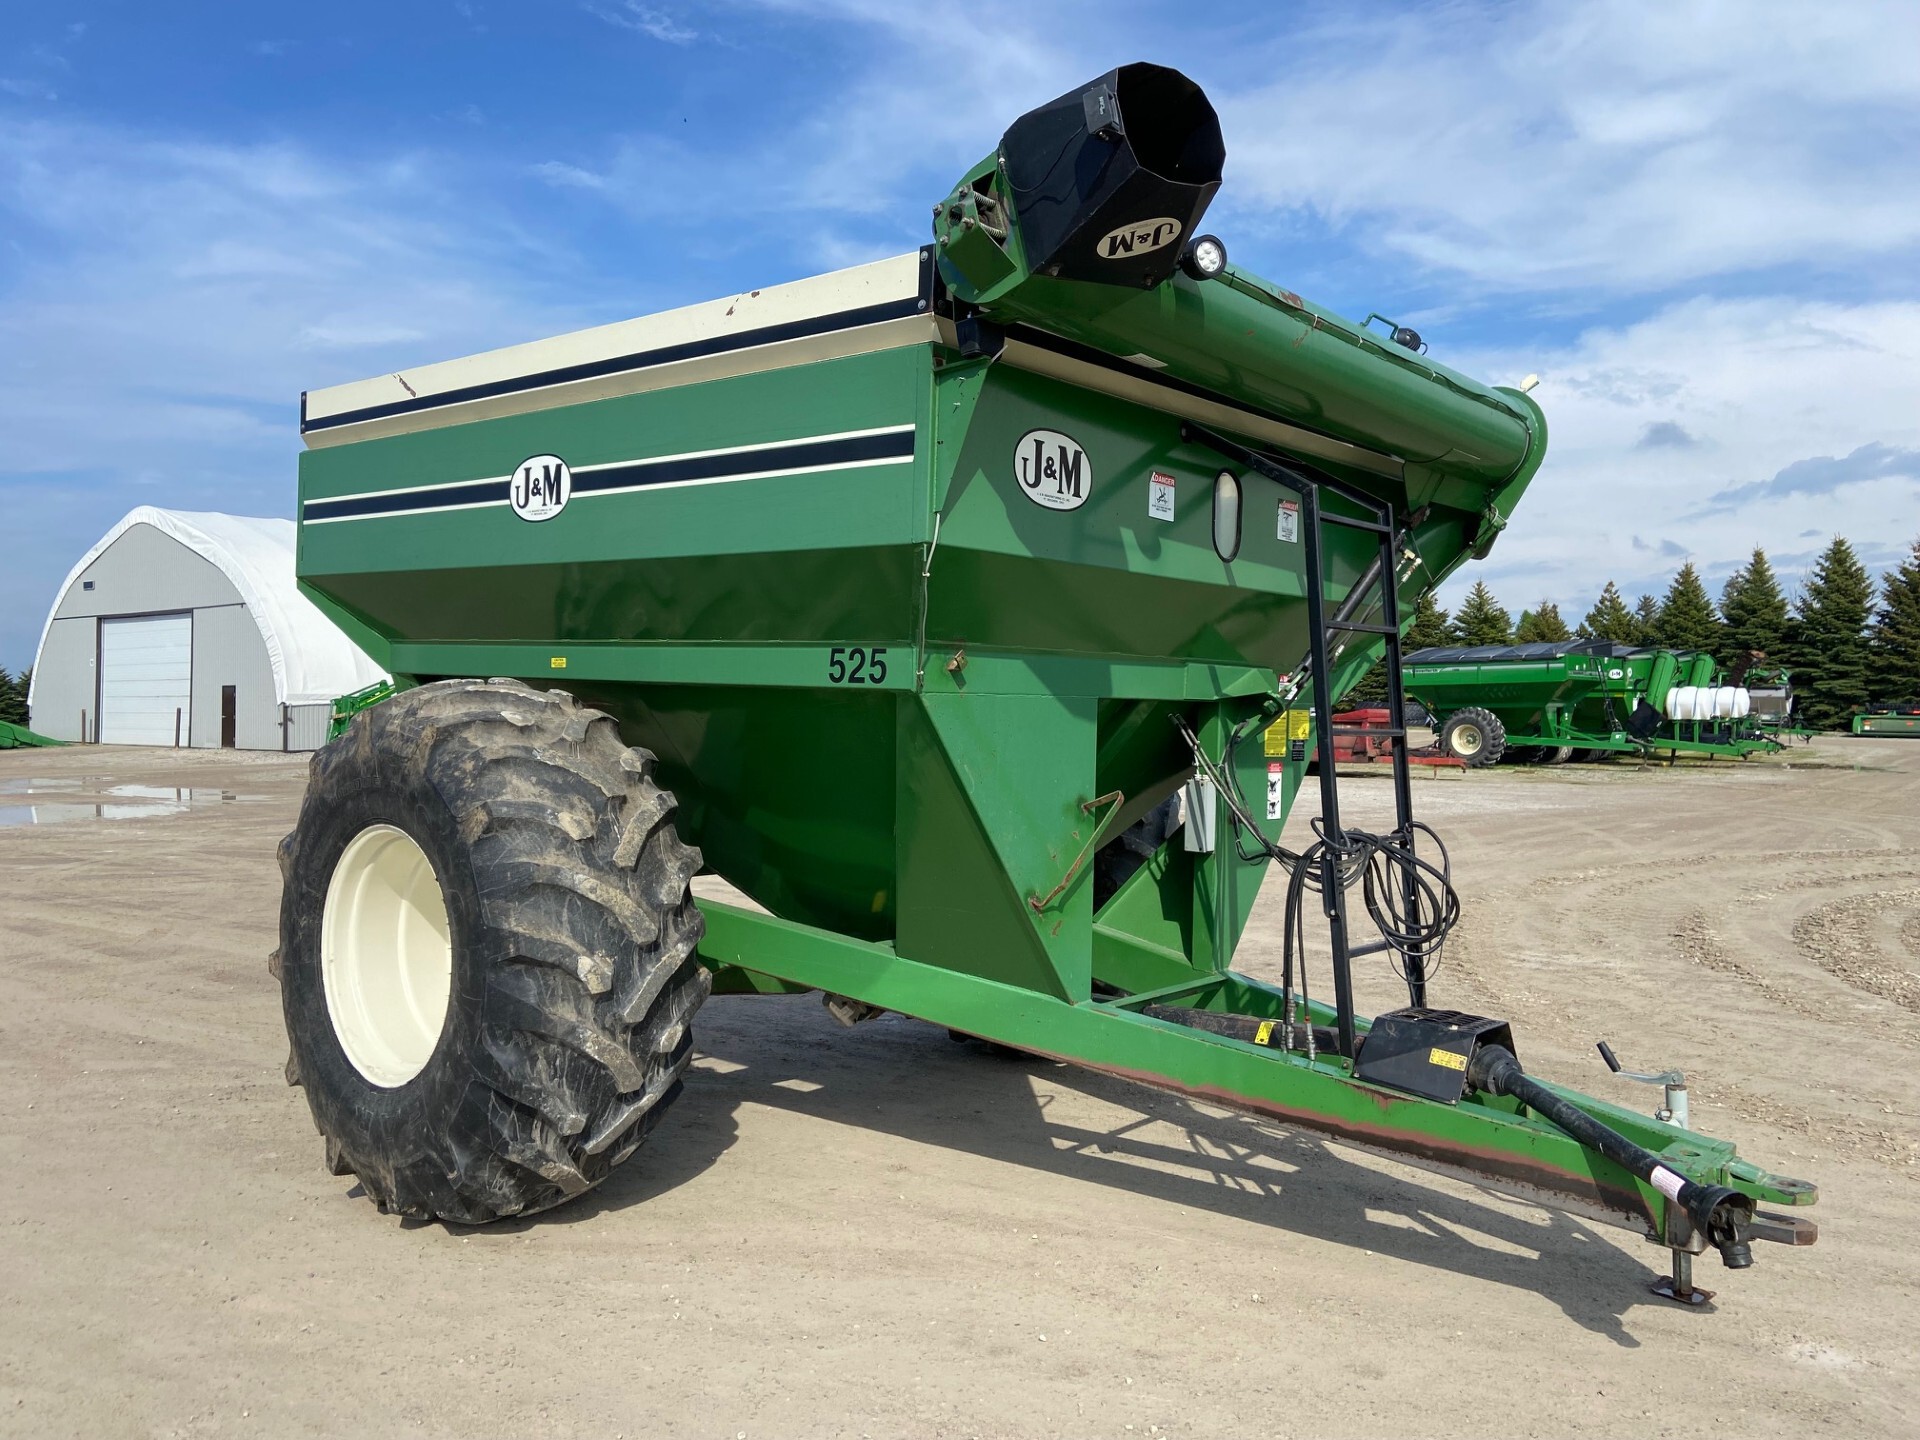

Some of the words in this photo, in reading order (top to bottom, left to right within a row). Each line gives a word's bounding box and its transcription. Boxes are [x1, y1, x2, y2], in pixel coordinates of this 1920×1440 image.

[1106, 222, 1174, 257] J&M
[515, 463, 563, 509] J&M
[1021, 439, 1083, 498] J&M
[1154, 474, 1175, 486] DANGER
[829, 648, 887, 684] 525
